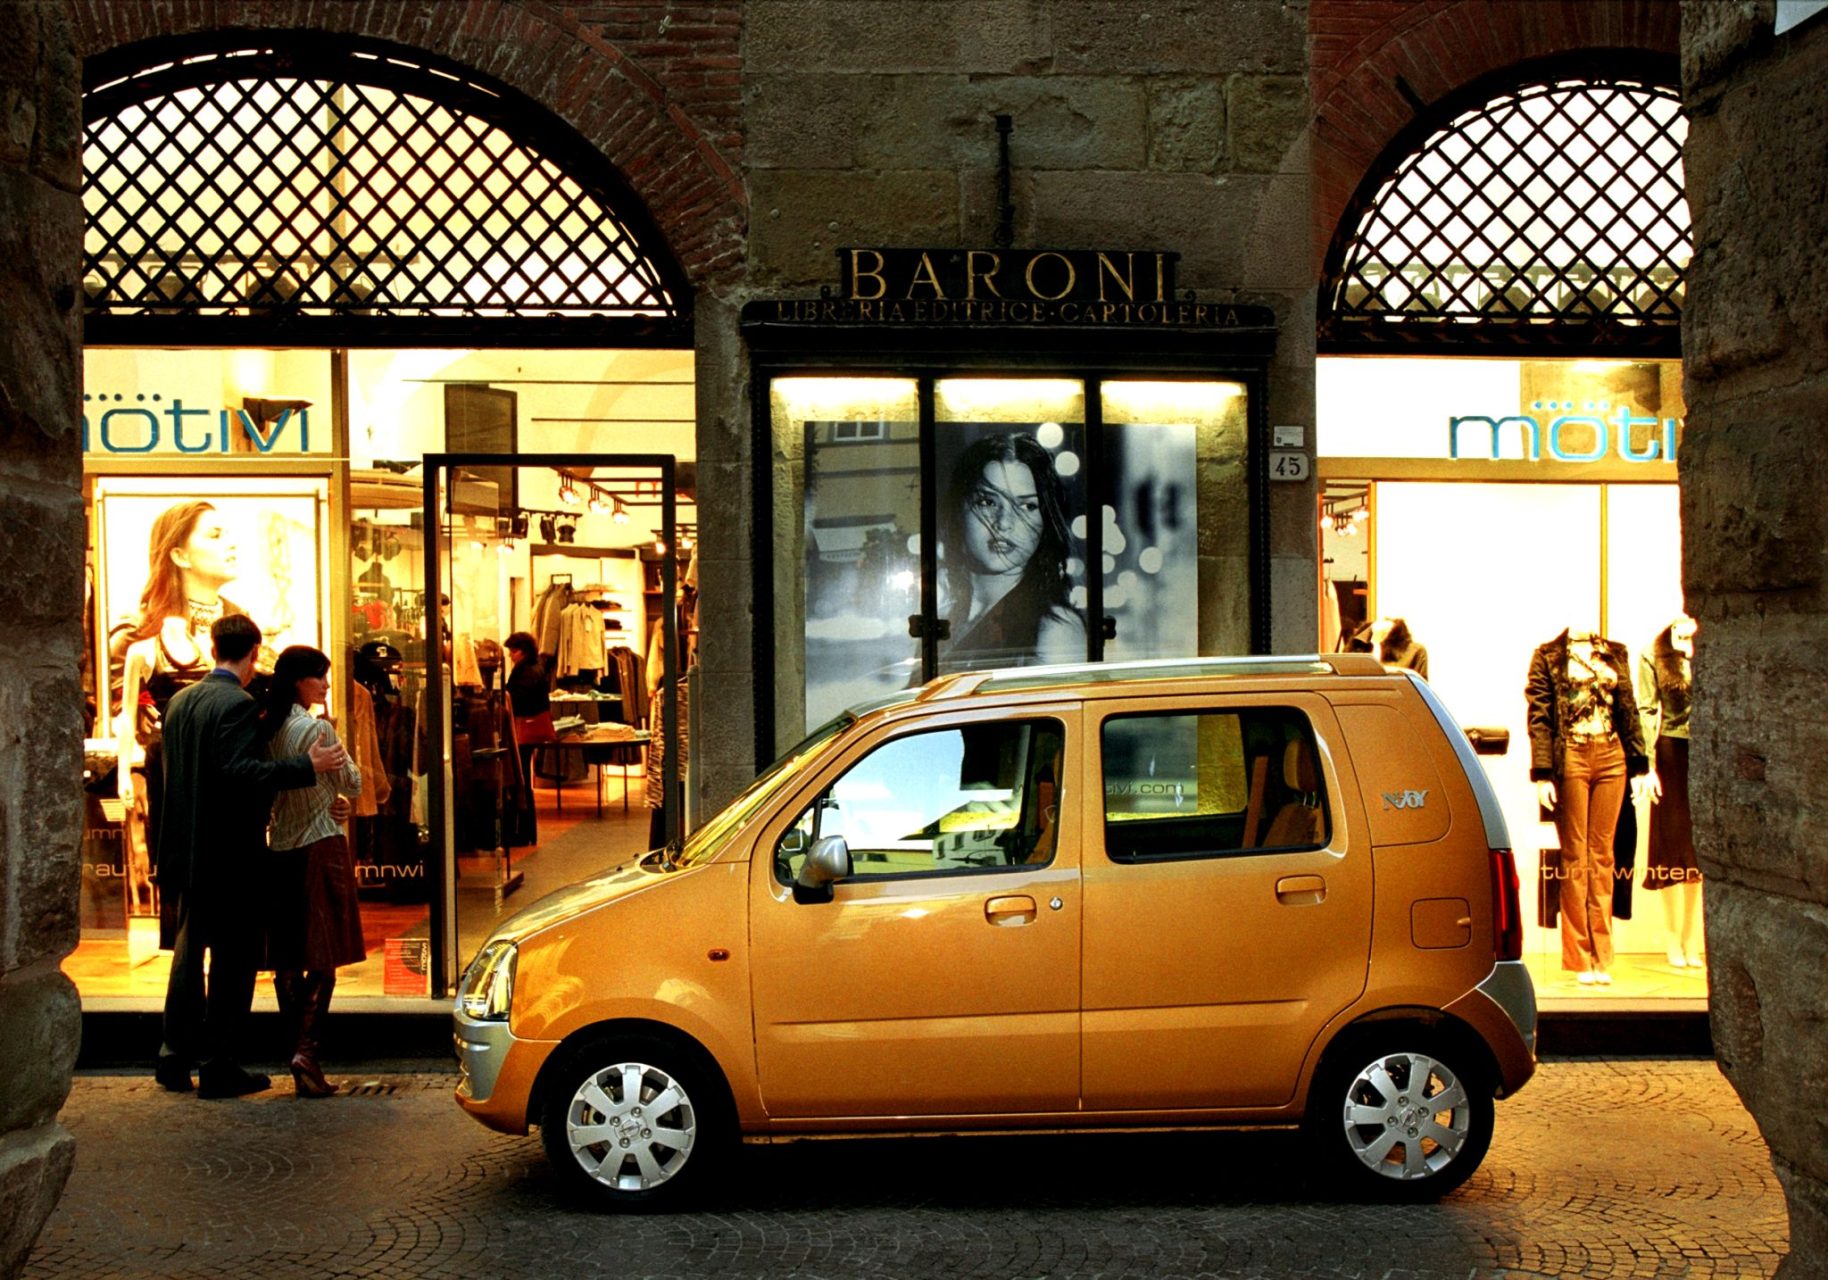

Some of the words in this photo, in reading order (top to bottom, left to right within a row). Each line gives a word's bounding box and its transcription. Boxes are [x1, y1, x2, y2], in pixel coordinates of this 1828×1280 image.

[850, 249, 1167, 303] BARONI
[777, 301, 905, 321] LIBRERIA
[914, 302, 1046, 323] EDITRICE
[1060, 303, 1240, 325] CARTOLERIA
[1275, 456, 1301, 476] 45
